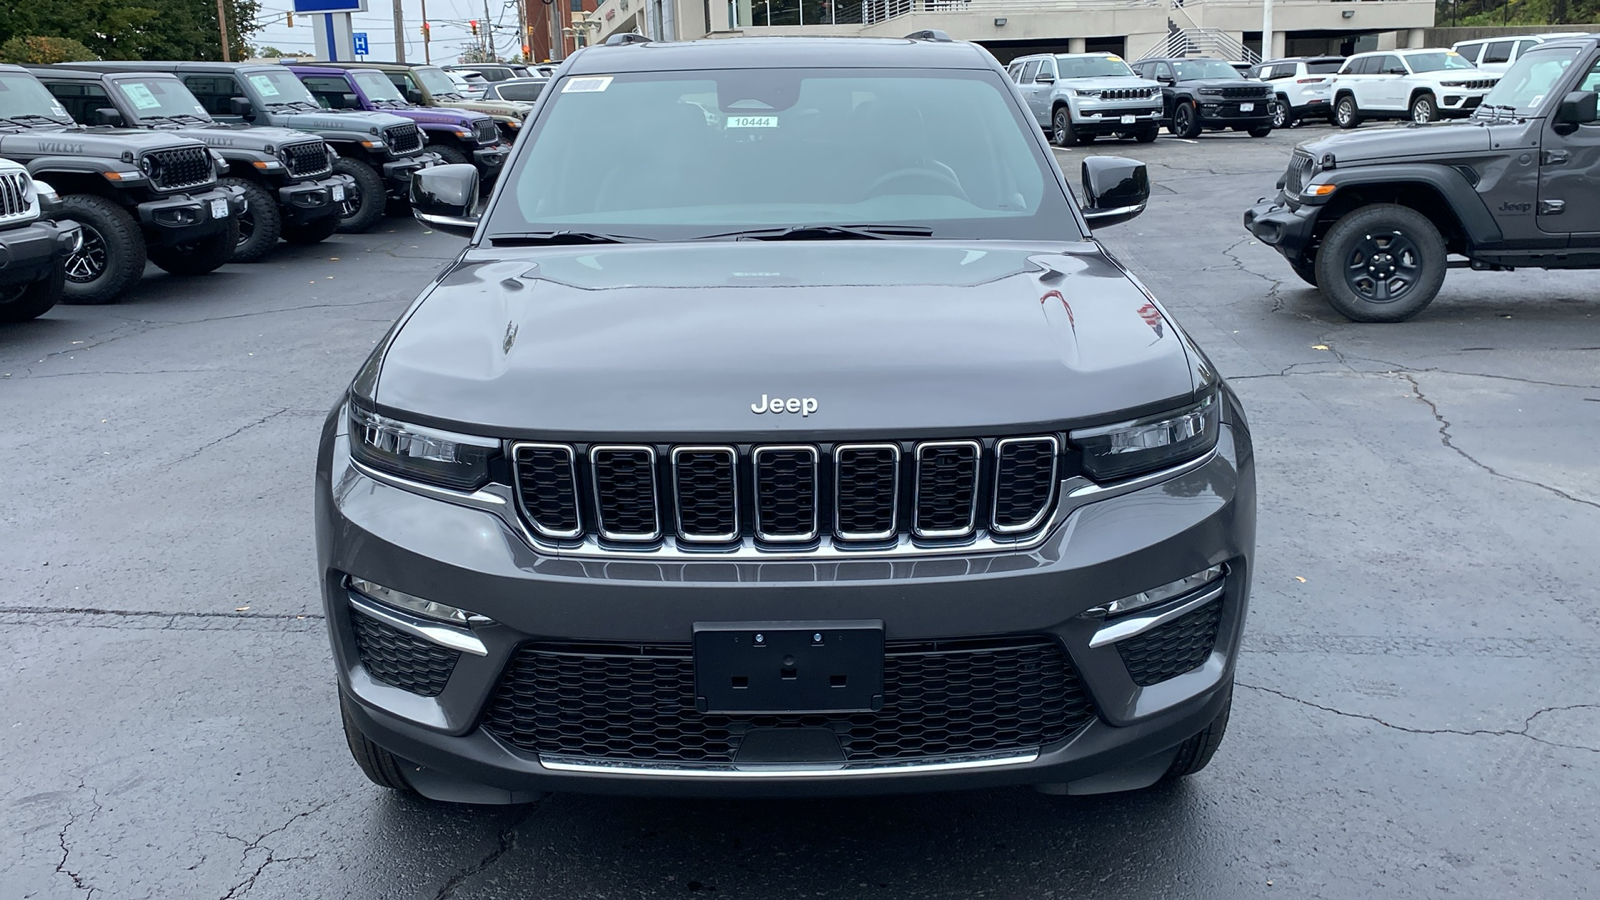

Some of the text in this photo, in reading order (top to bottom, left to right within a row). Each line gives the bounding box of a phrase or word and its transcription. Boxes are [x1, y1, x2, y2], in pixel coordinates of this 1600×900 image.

[355, 37, 365, 49] H
[734, 117, 770, 127] 10444
[38, 142, 85, 153] WILLYS
[1498, 201, 1532, 213] Jeep
[750, 394, 818, 418] Jeep
